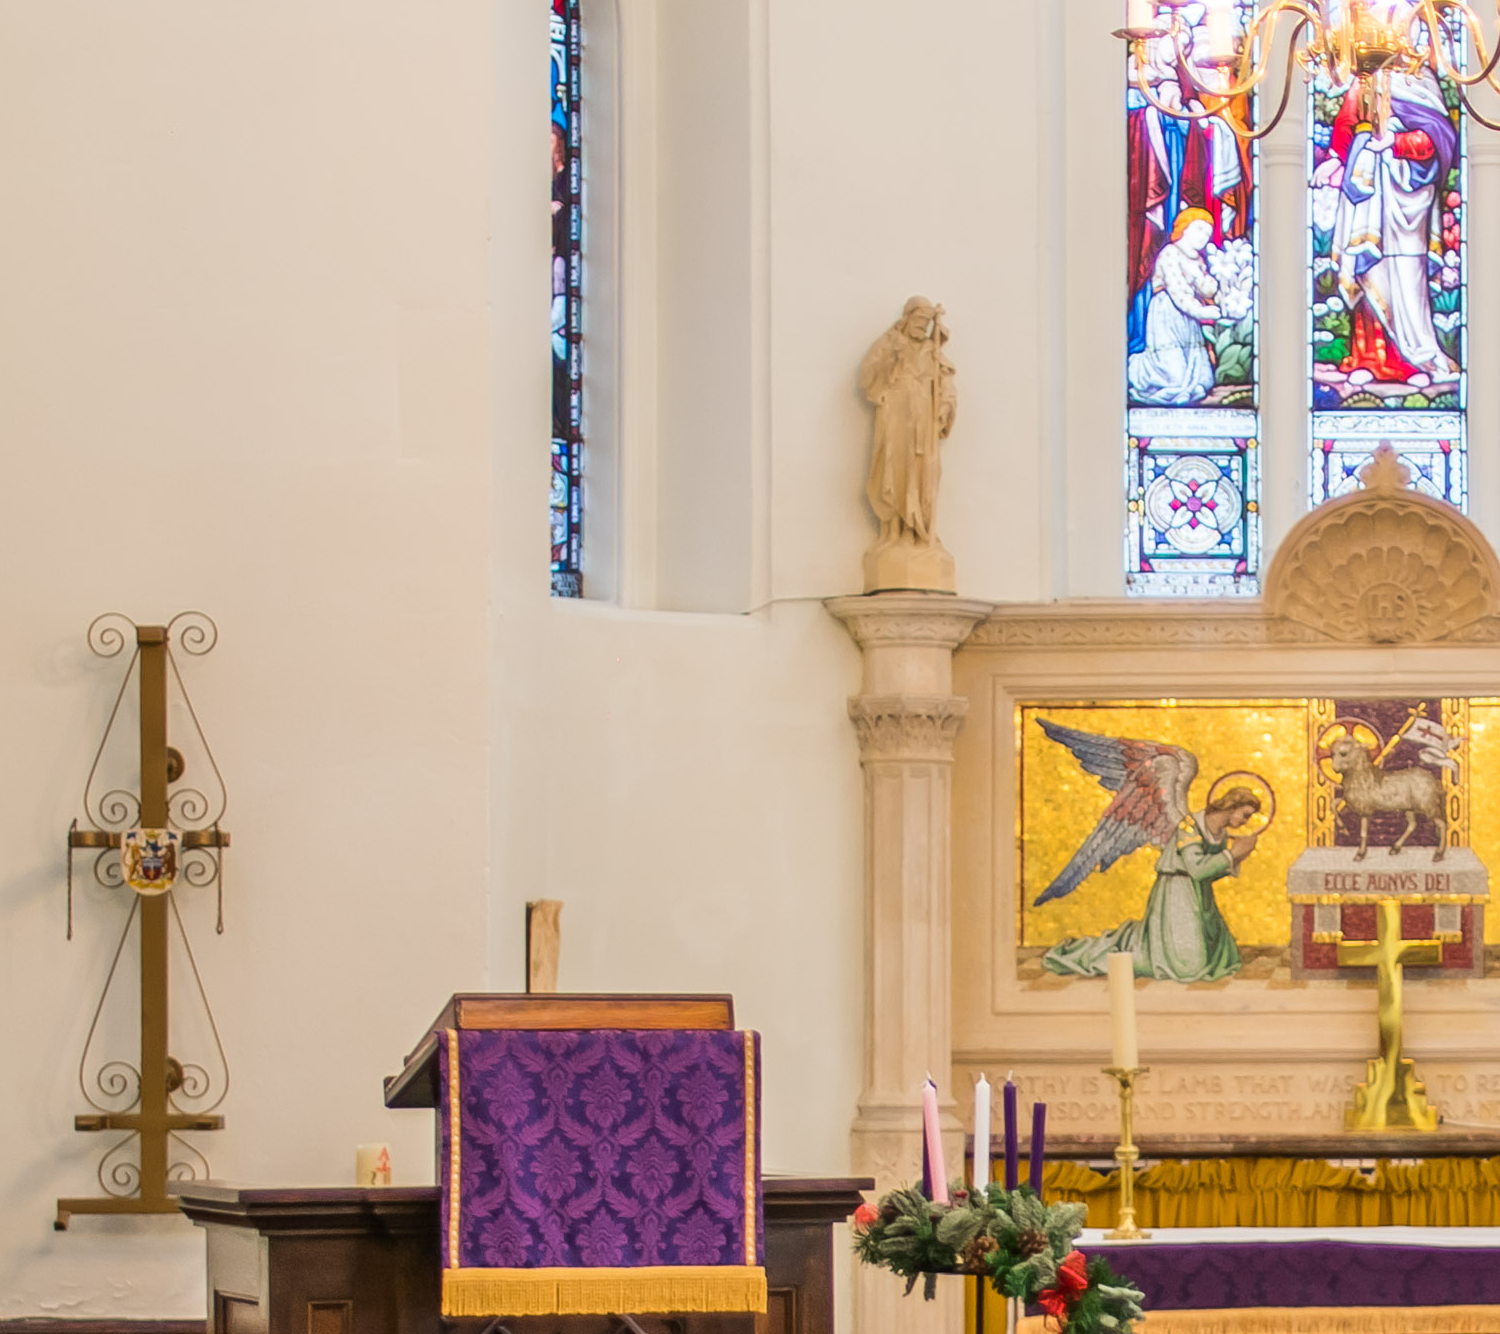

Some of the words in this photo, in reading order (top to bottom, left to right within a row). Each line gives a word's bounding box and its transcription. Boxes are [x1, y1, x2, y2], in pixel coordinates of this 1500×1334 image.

[1324, 873, 1361, 891] ECCE
[1424, 873, 1451, 891] DEI
[1080, 1074, 1100, 1094] IS
[1105, 1074, 1152, 1094] TE
[1159, 1069, 1222, 1094] LAMB
[1233, 1074, 1294, 1094] THAT
[1307, 1074, 1355, 1094] WAS
[1436, 1074, 1469, 1093] TO
